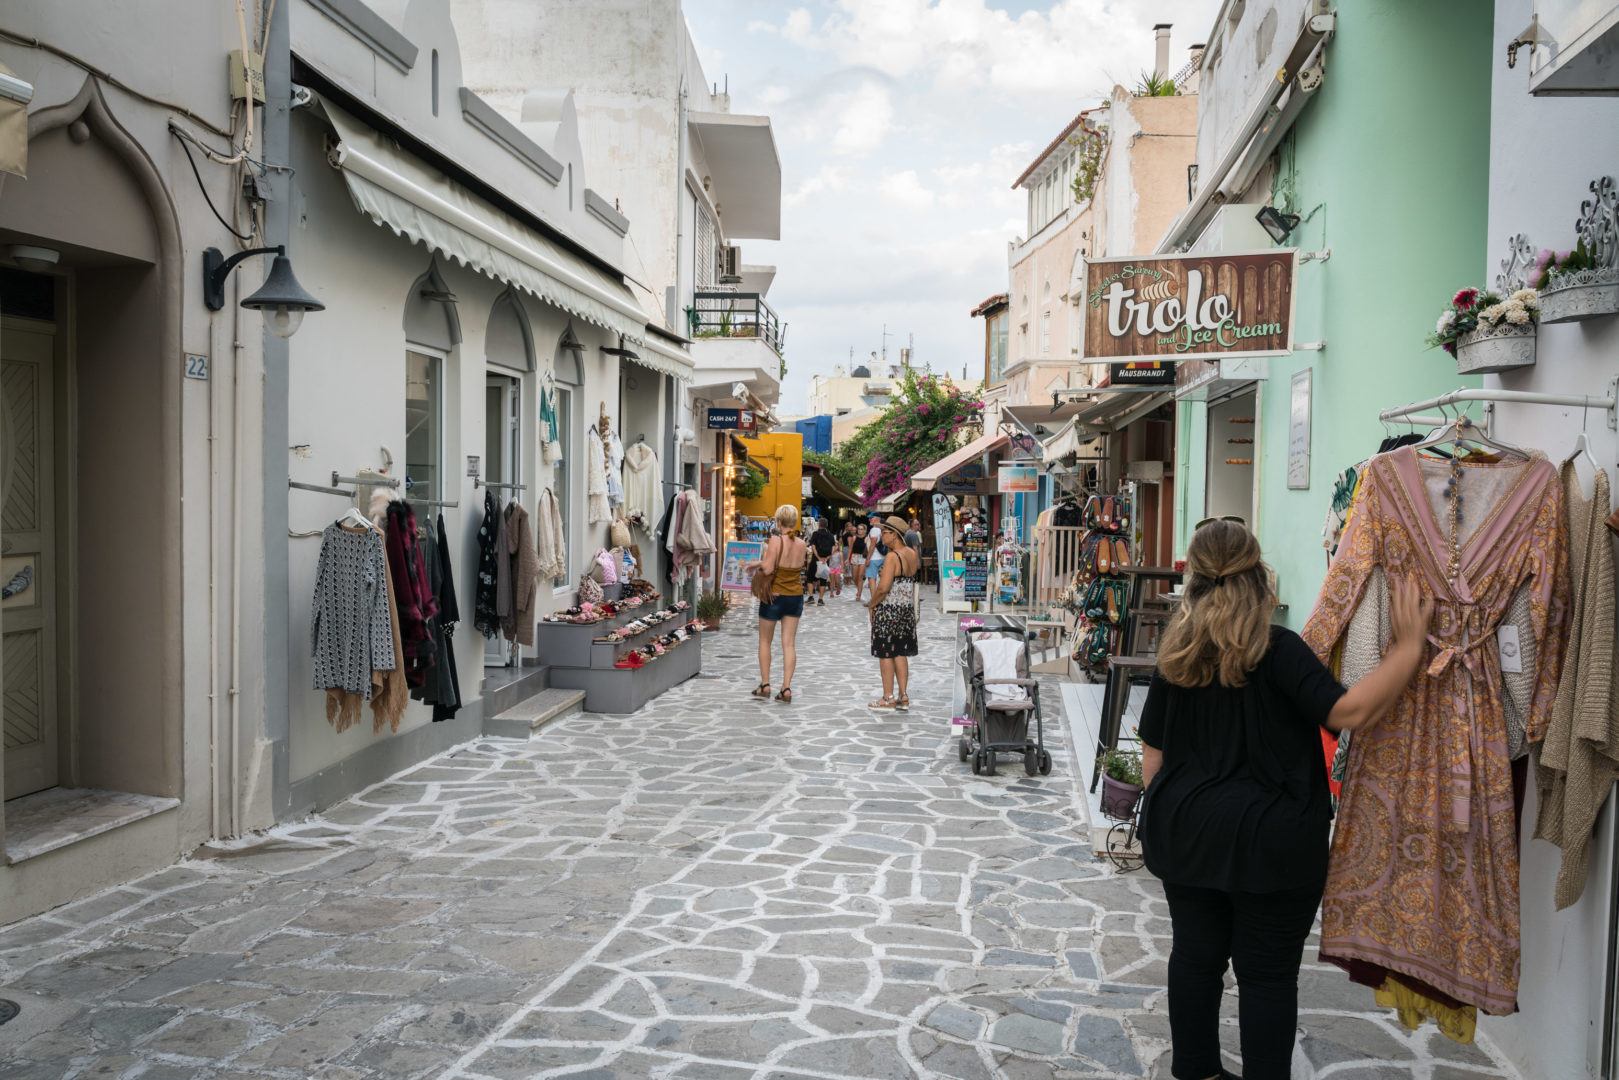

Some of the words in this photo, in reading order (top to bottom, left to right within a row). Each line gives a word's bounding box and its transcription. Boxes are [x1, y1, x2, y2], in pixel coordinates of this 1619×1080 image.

[1102, 269, 1235, 337] trolo
[1157, 334, 1176, 345] and
[1175, 324, 1214, 352] Ice
[1216, 318, 1284, 347] Cream
[188, 356, 205, 376] 22
[1118, 369, 1167, 378] HAUSBRANDT
